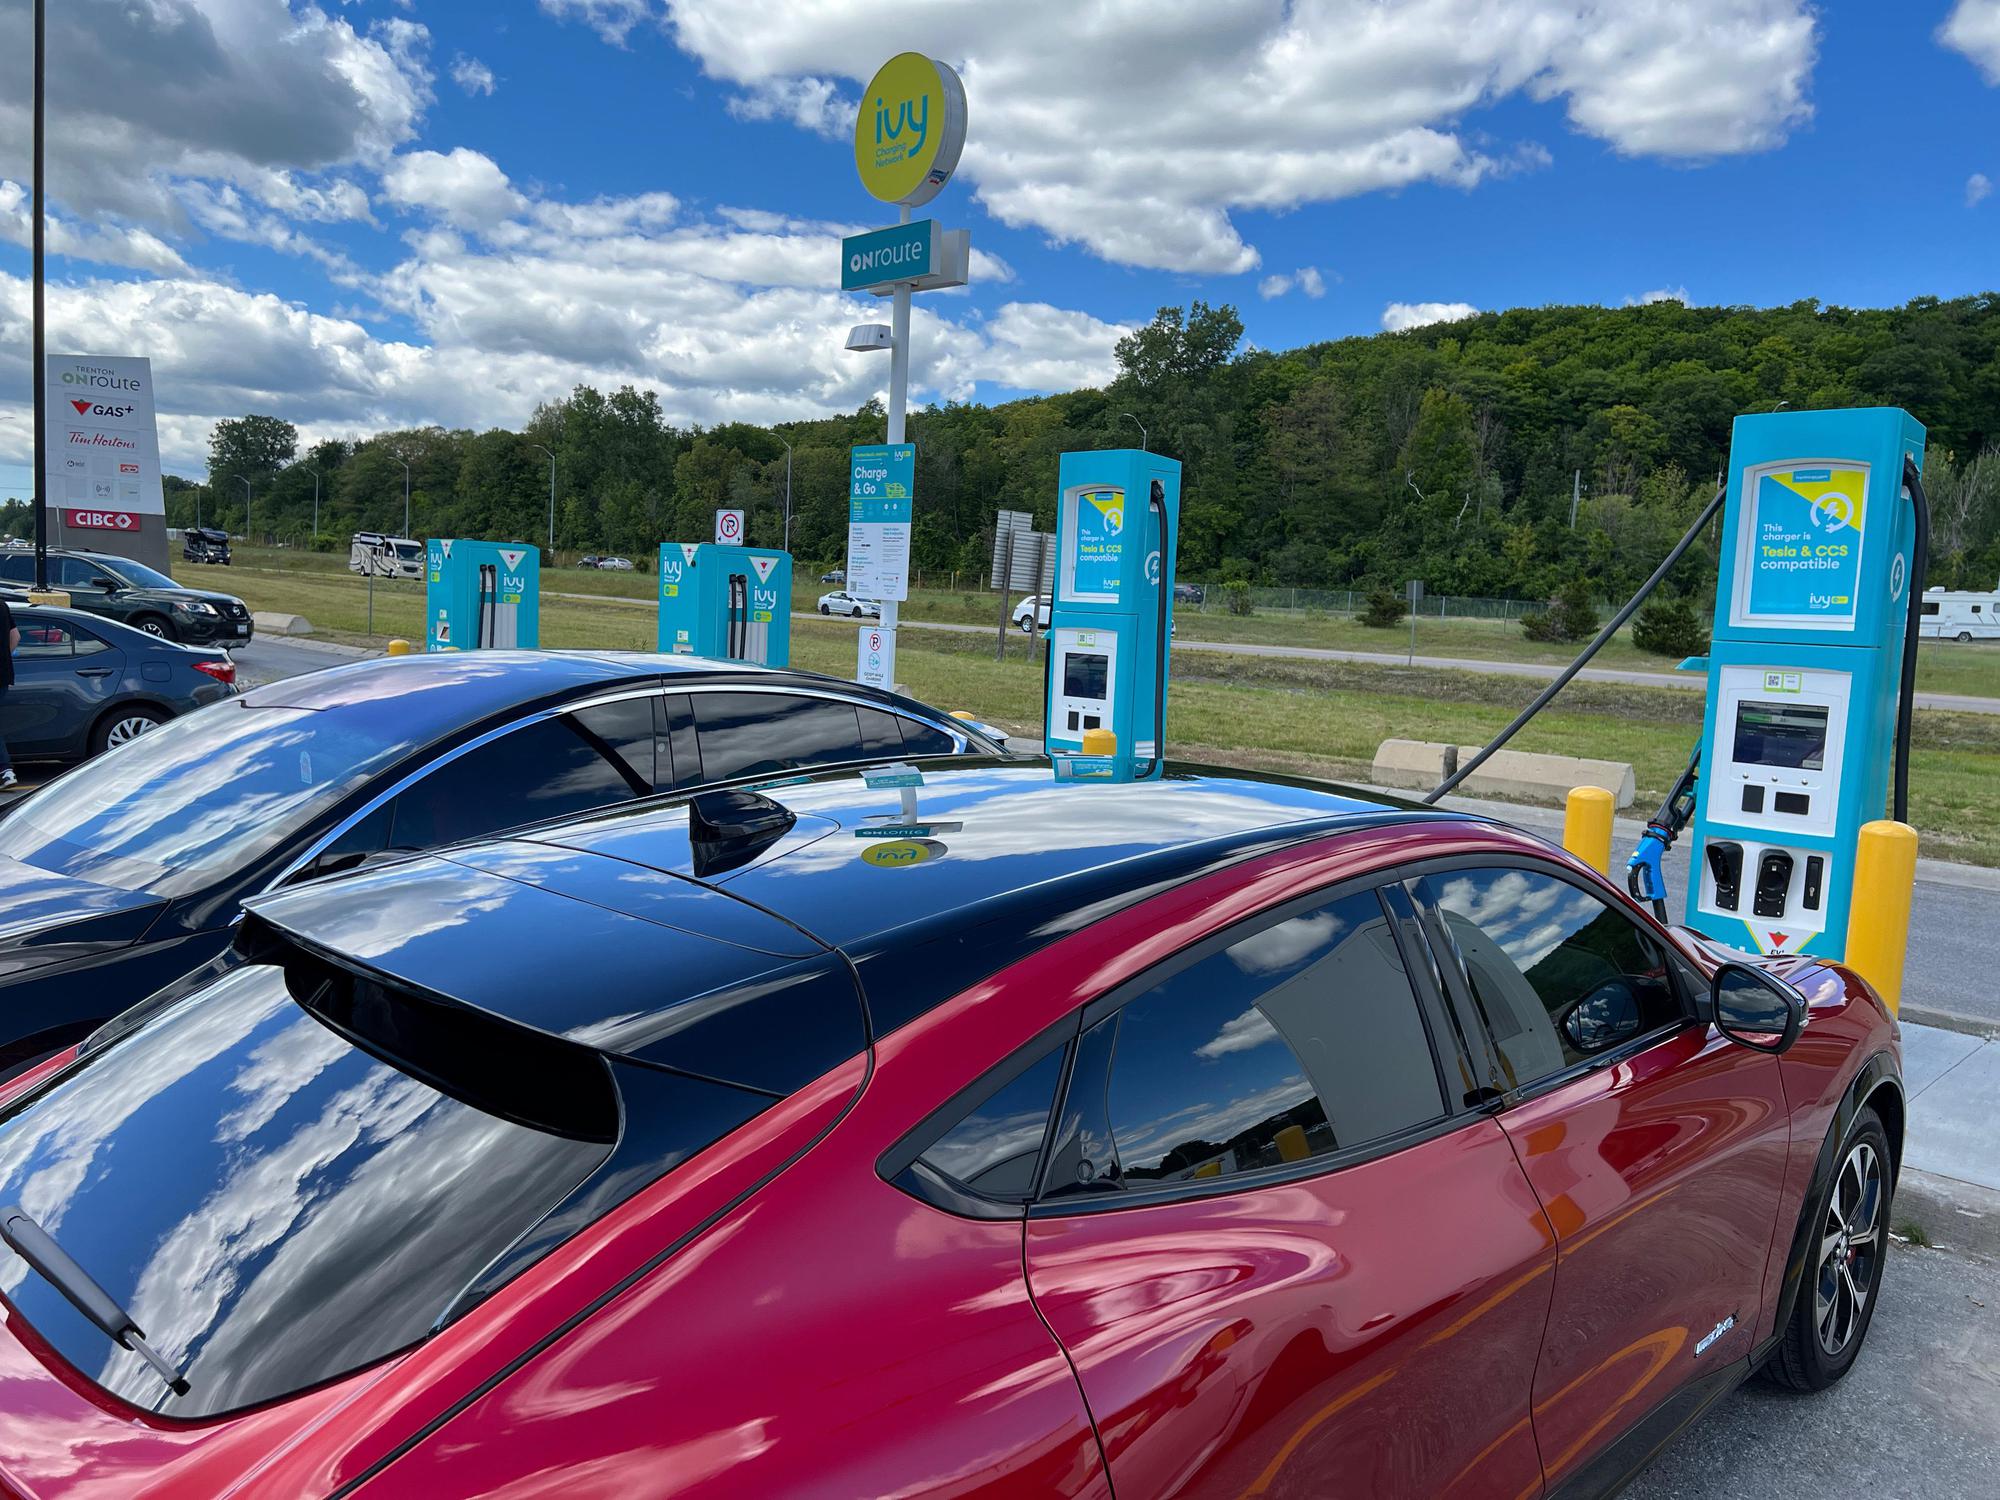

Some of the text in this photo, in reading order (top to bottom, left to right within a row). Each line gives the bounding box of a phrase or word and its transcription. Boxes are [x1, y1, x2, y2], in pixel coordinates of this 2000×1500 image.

[875, 94, 928, 158] ivy
[850, 240, 922, 273] ONroute
[76, 366, 114, 375] TRENTON
[62, 372, 141, 391] ONroute
[69, 431, 136, 449] Tim Hortons
[854, 466, 888, 482] Charge
[854, 482, 876, 495] & Go
[75, 512, 114, 527] CIBC
[1081, 528, 1091, 536] This
[1764, 523, 1783, 532] This
[1762, 532, 1811, 543] charger is
[1080, 544, 1122, 553] Tesla & CCS
[1761, 545, 1848, 557] Tesla & CCS
[430, 549, 442, 571] ivy
[1079, 553, 1118, 562] compatible
[1760, 557, 1840, 572] compatible
[664, 555, 682, 583] ivy
[503, 573, 524, 593] ivy
[754, 585, 776, 610] ivy
[1809, 592, 1830, 608] ivy
